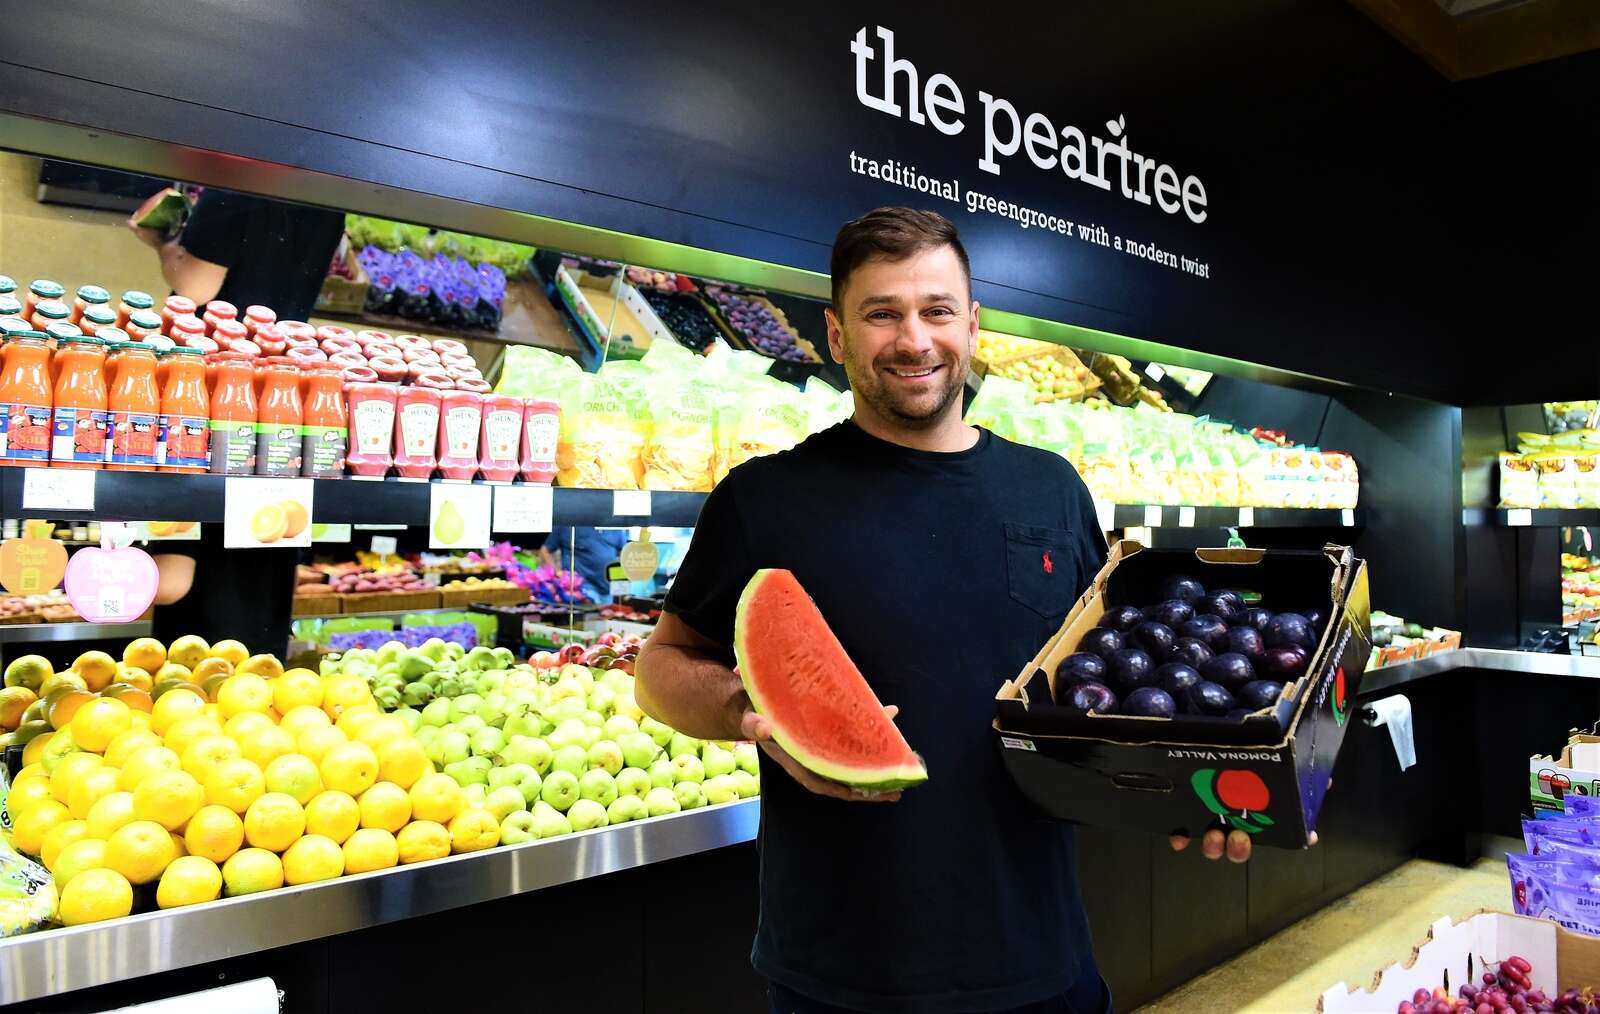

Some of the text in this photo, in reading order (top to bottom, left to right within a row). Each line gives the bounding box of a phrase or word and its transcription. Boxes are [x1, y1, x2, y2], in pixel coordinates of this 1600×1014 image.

[850, 25, 1208, 224] the peartree
[850, 150, 1210, 279] traditional greengrocer with a modern twist
[409, 408, 434, 417] HEINZ
[1167, 749, 1282, 762] POMONA VALLEY
